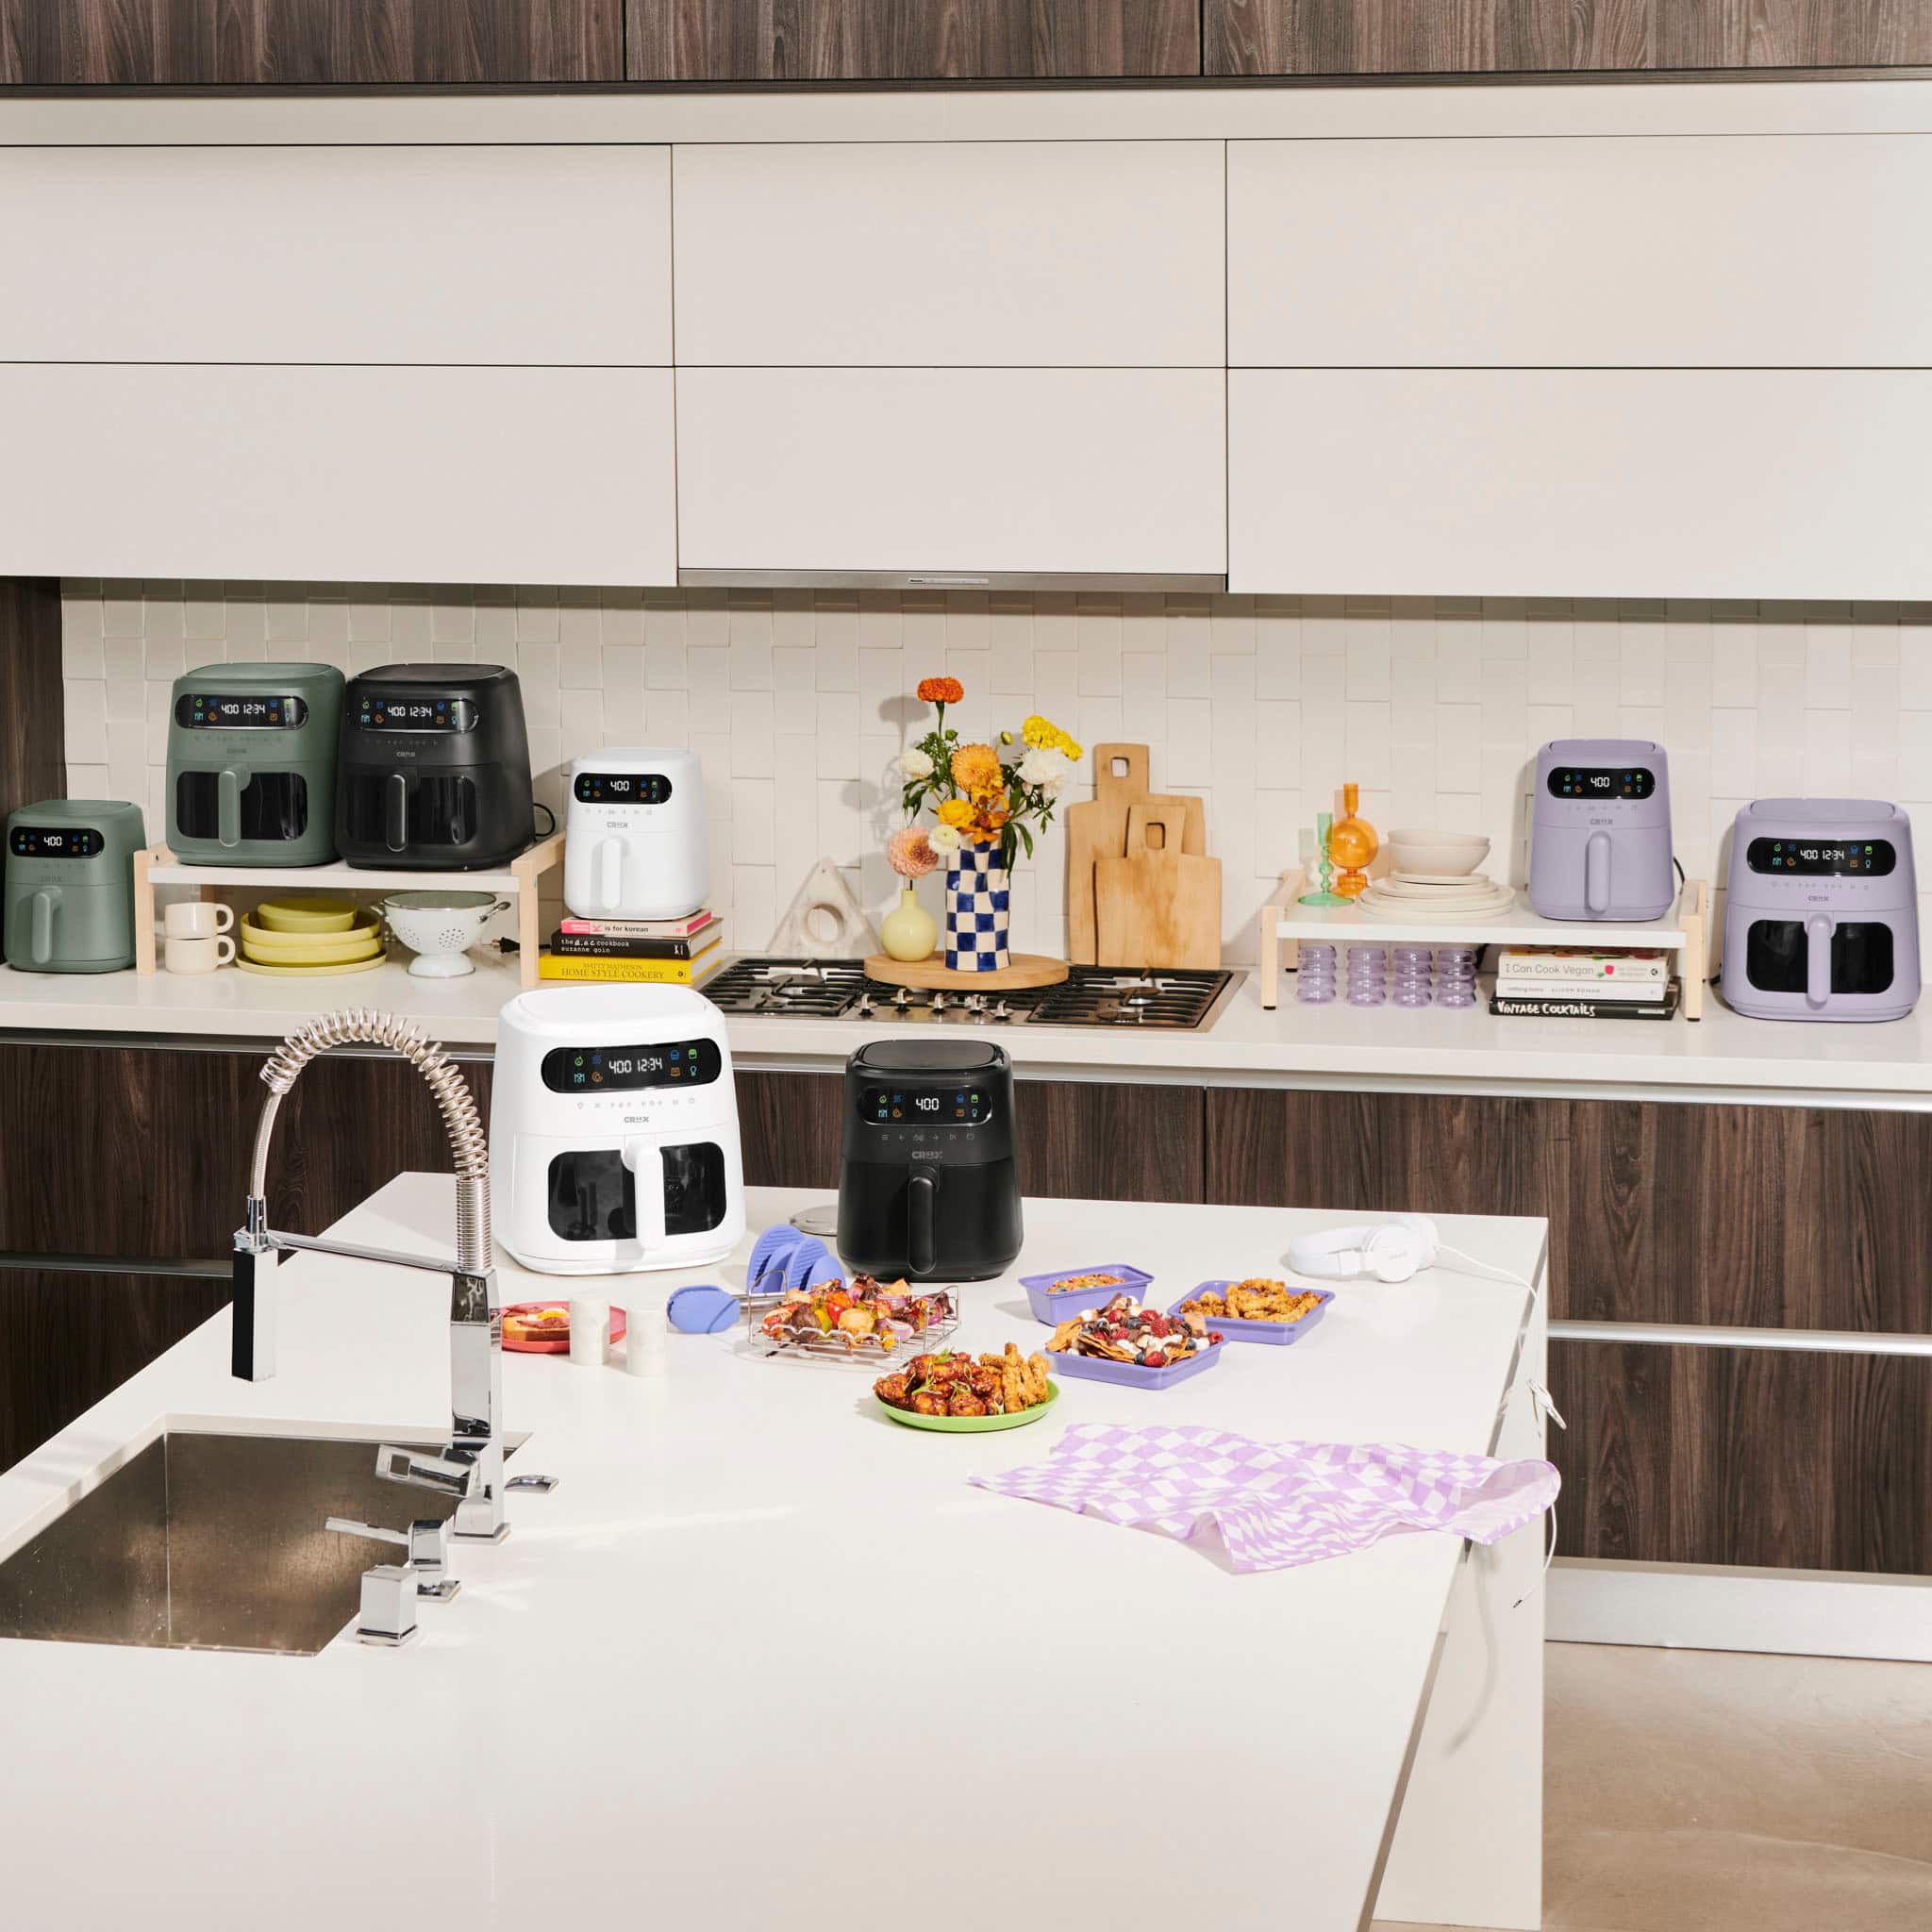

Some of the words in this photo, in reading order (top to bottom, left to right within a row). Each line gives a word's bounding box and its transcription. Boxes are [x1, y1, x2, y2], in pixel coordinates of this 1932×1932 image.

[221, 704, 240, 715] 400
[387, 707, 406, 717] 400
[610, 780, 630, 791] 400
[1591, 776, 1610, 788] 400
[43, 836, 62, 847] 400
[1800, 849, 1819, 860] 400
[1822, 849, 1845, 860] 12:34
[622, 970, 665, 979] COOKERY
[1512, 964, 1532, 974] Can
[1535, 964, 1560, 974] Cook
[1562, 965, 1594, 976] Vegan
[608, 1059, 632, 1074] 400
[637, 1058, 662, 1073] 12:34
[915, 1097, 940, 1110] 400
